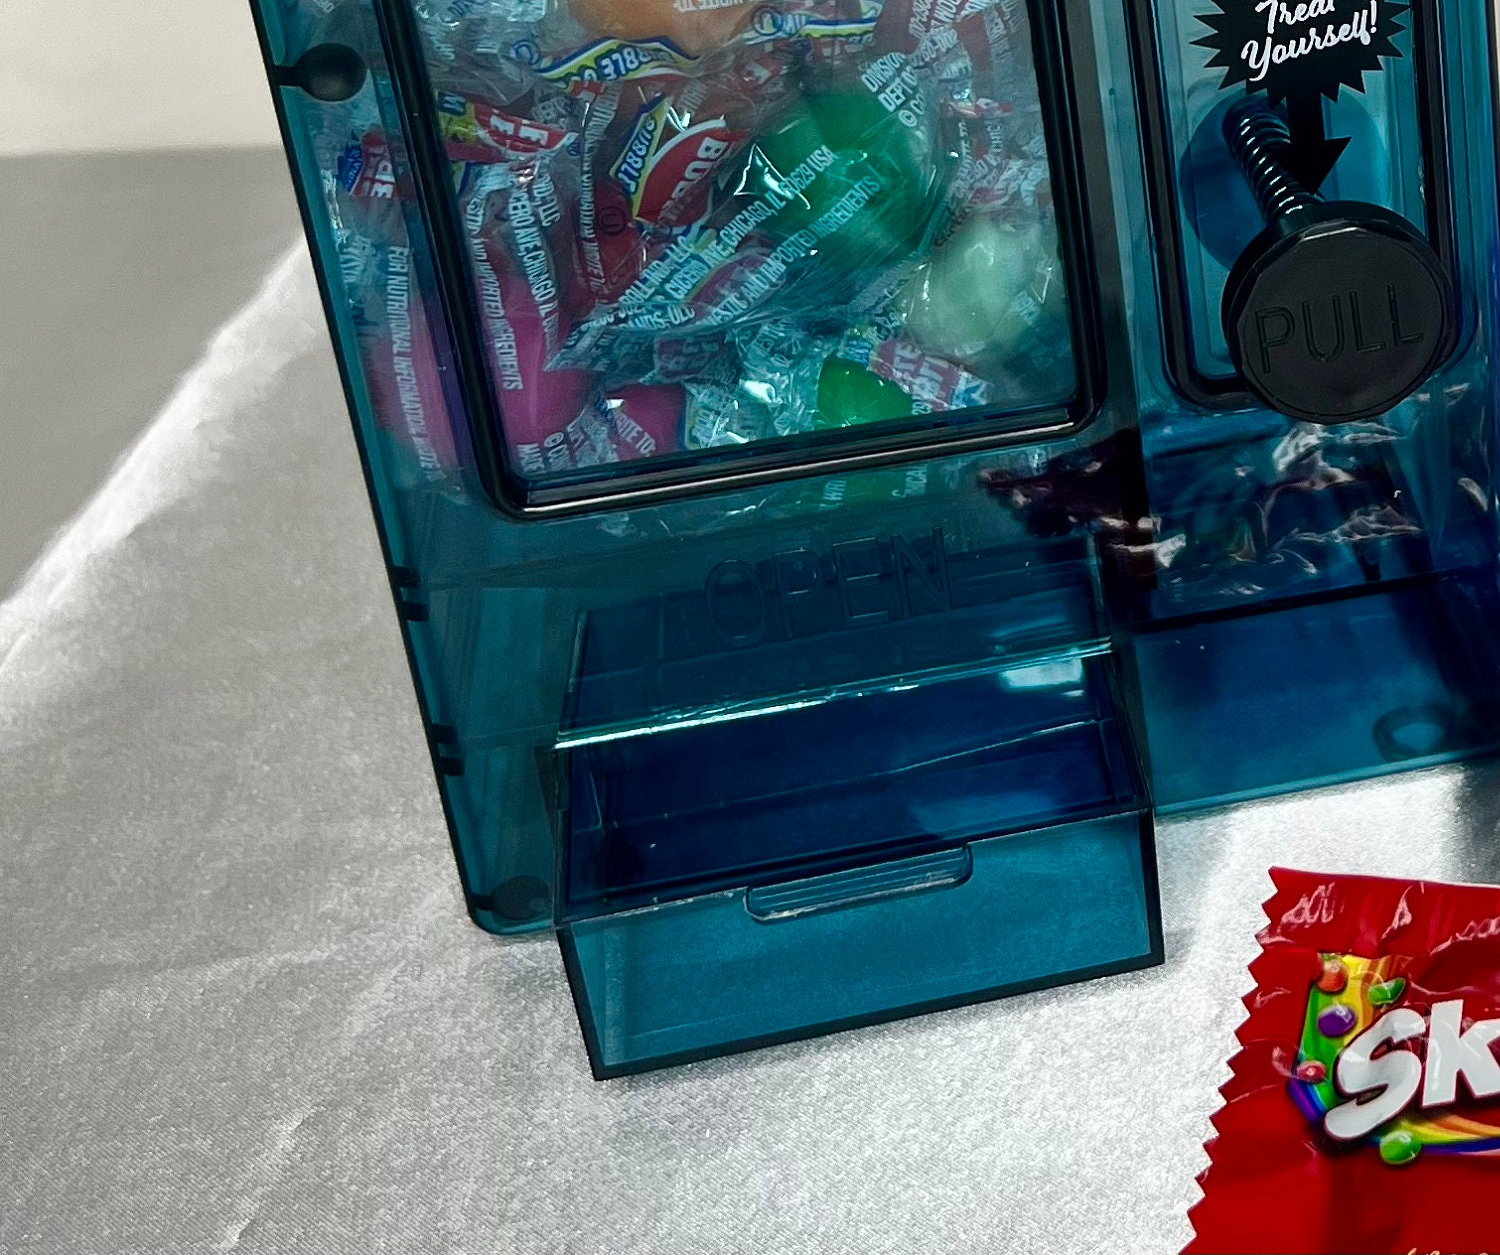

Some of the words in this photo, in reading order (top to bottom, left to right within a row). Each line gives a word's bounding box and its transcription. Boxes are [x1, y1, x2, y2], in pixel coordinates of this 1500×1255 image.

[1240, 0, 1378, 82] Yourself!
[878, 83, 907, 113] DEPT
[810, 145, 838, 174] USA
[389, 246, 409, 271] FOR
[744, 269, 770, 301] AND
[764, 229, 818, 287] IMPORTED
[812, 176, 881, 239] INGREDIENTS
[387, 272, 412, 357] NUTRITIONAL
[492, 318, 523, 391] INGREDIENTS
[1254, 283, 1424, 374] PULL
[703, 525, 954, 648] OPEN
